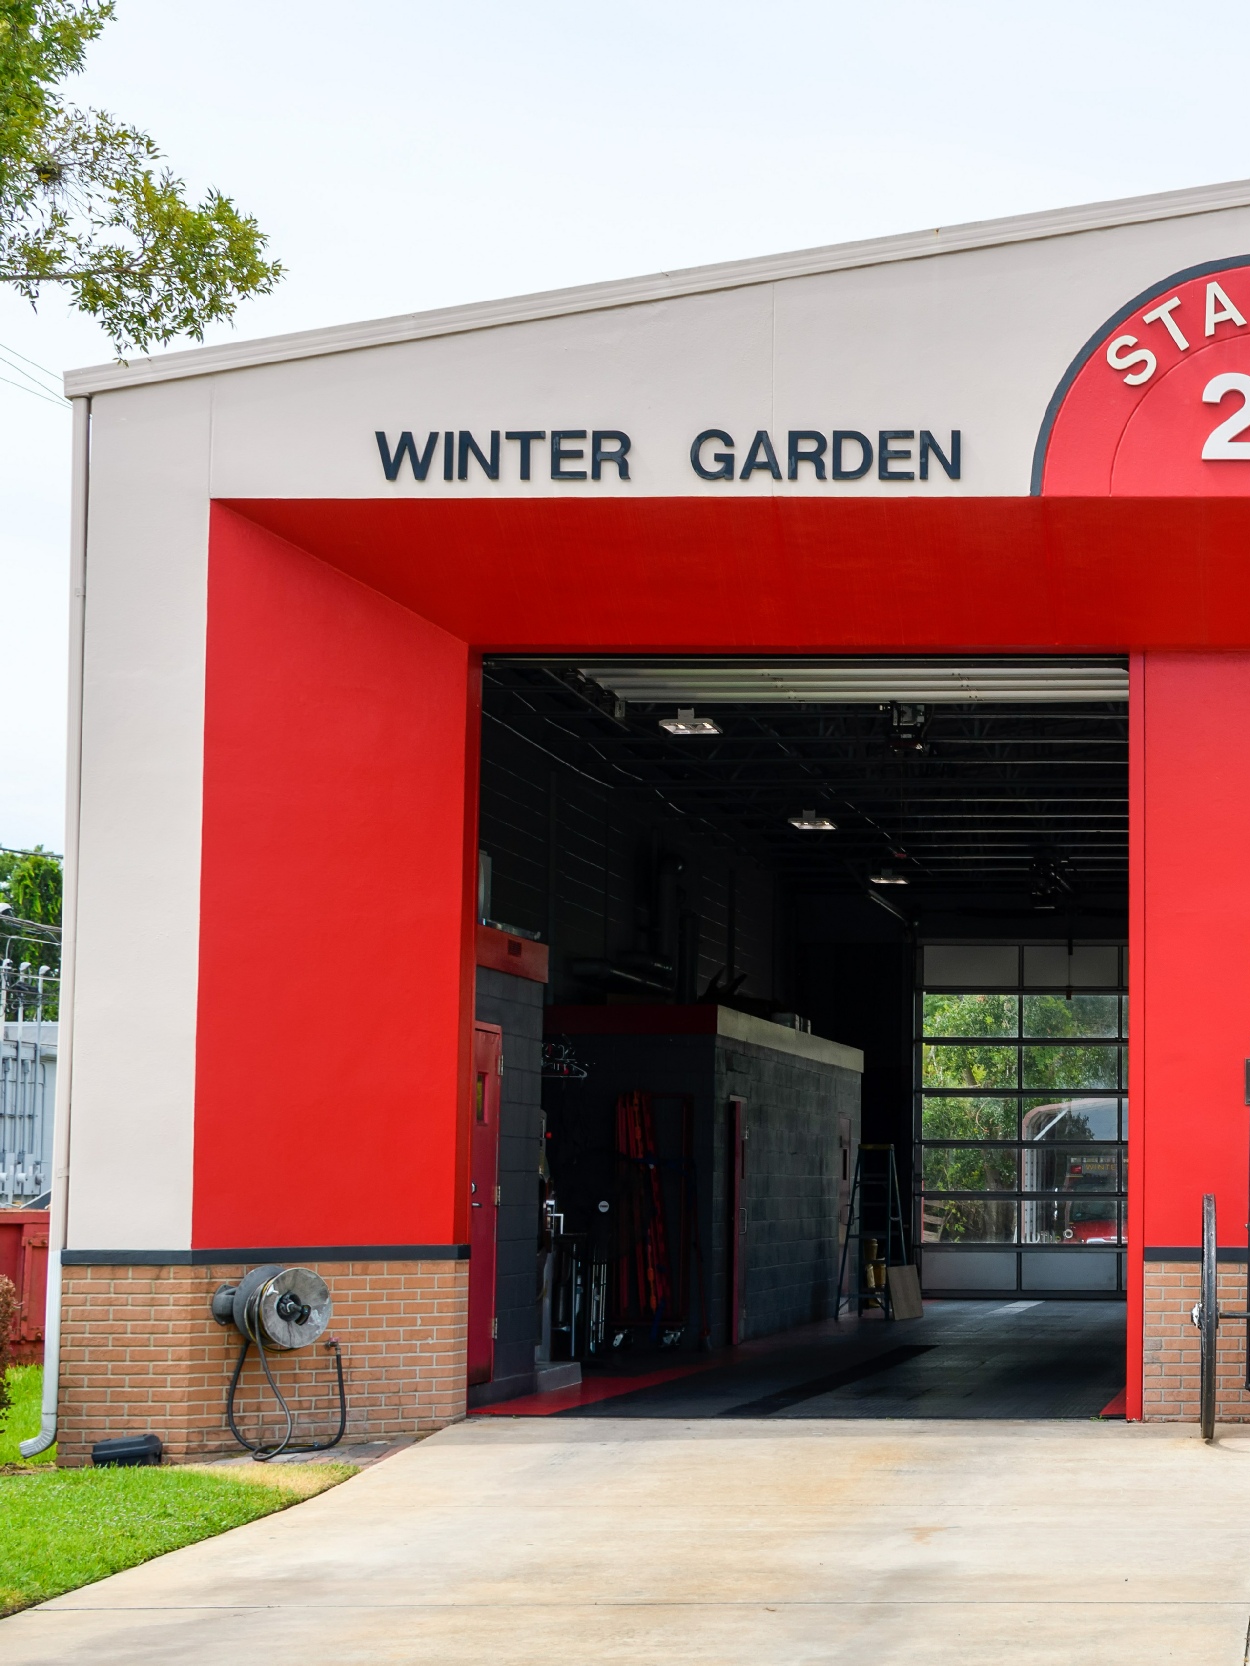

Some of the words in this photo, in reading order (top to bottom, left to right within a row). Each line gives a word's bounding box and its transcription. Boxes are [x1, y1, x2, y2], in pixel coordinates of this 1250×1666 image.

[374, 430, 632, 481] WINTER
[690, 428, 962, 481] GARDEN
[1085, 1163, 1116, 1171] WINTE
